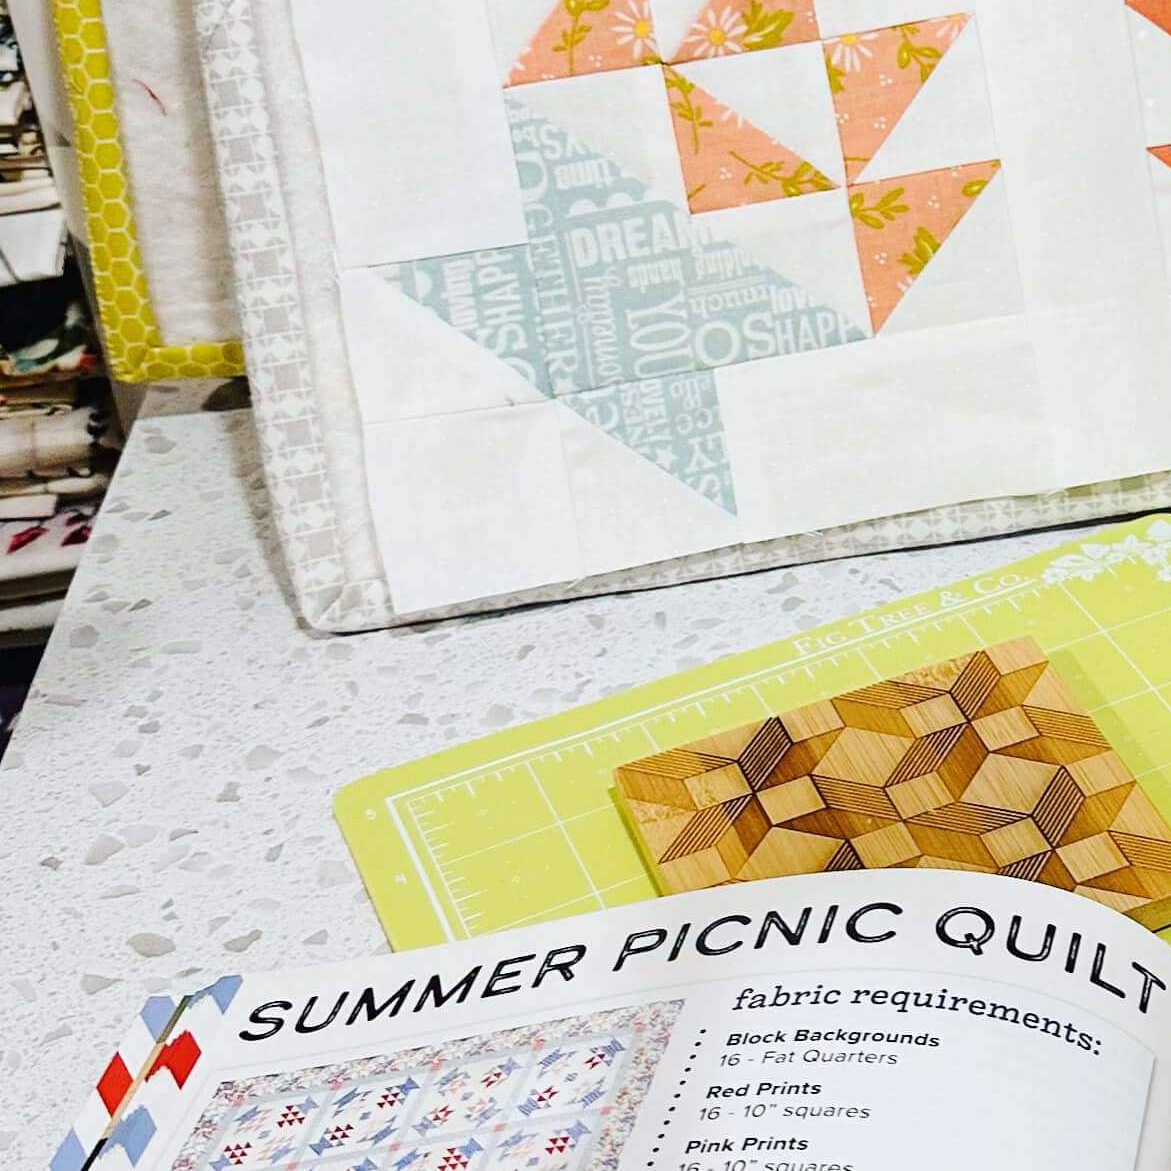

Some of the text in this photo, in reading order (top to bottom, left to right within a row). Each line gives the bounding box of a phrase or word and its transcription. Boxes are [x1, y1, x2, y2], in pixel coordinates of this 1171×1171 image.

[238, 902, 1168, 1042] SUMMER PICNIC QUILT
[731, 985, 1104, 1058] fabric requirements:
[726, 1028, 942, 1048] Block Backgrounds
[719, 1053, 742, 1067] 16
[761, 1050, 796, 1065] Fat
[802, 1049, 899, 1065] Quarters
[706, 1081, 823, 1099] Red Prints
[699, 1106, 722, 1121] 16
[782, 1104, 872, 1121] squares
[684, 1137, 810, 1155] Pink Prints
